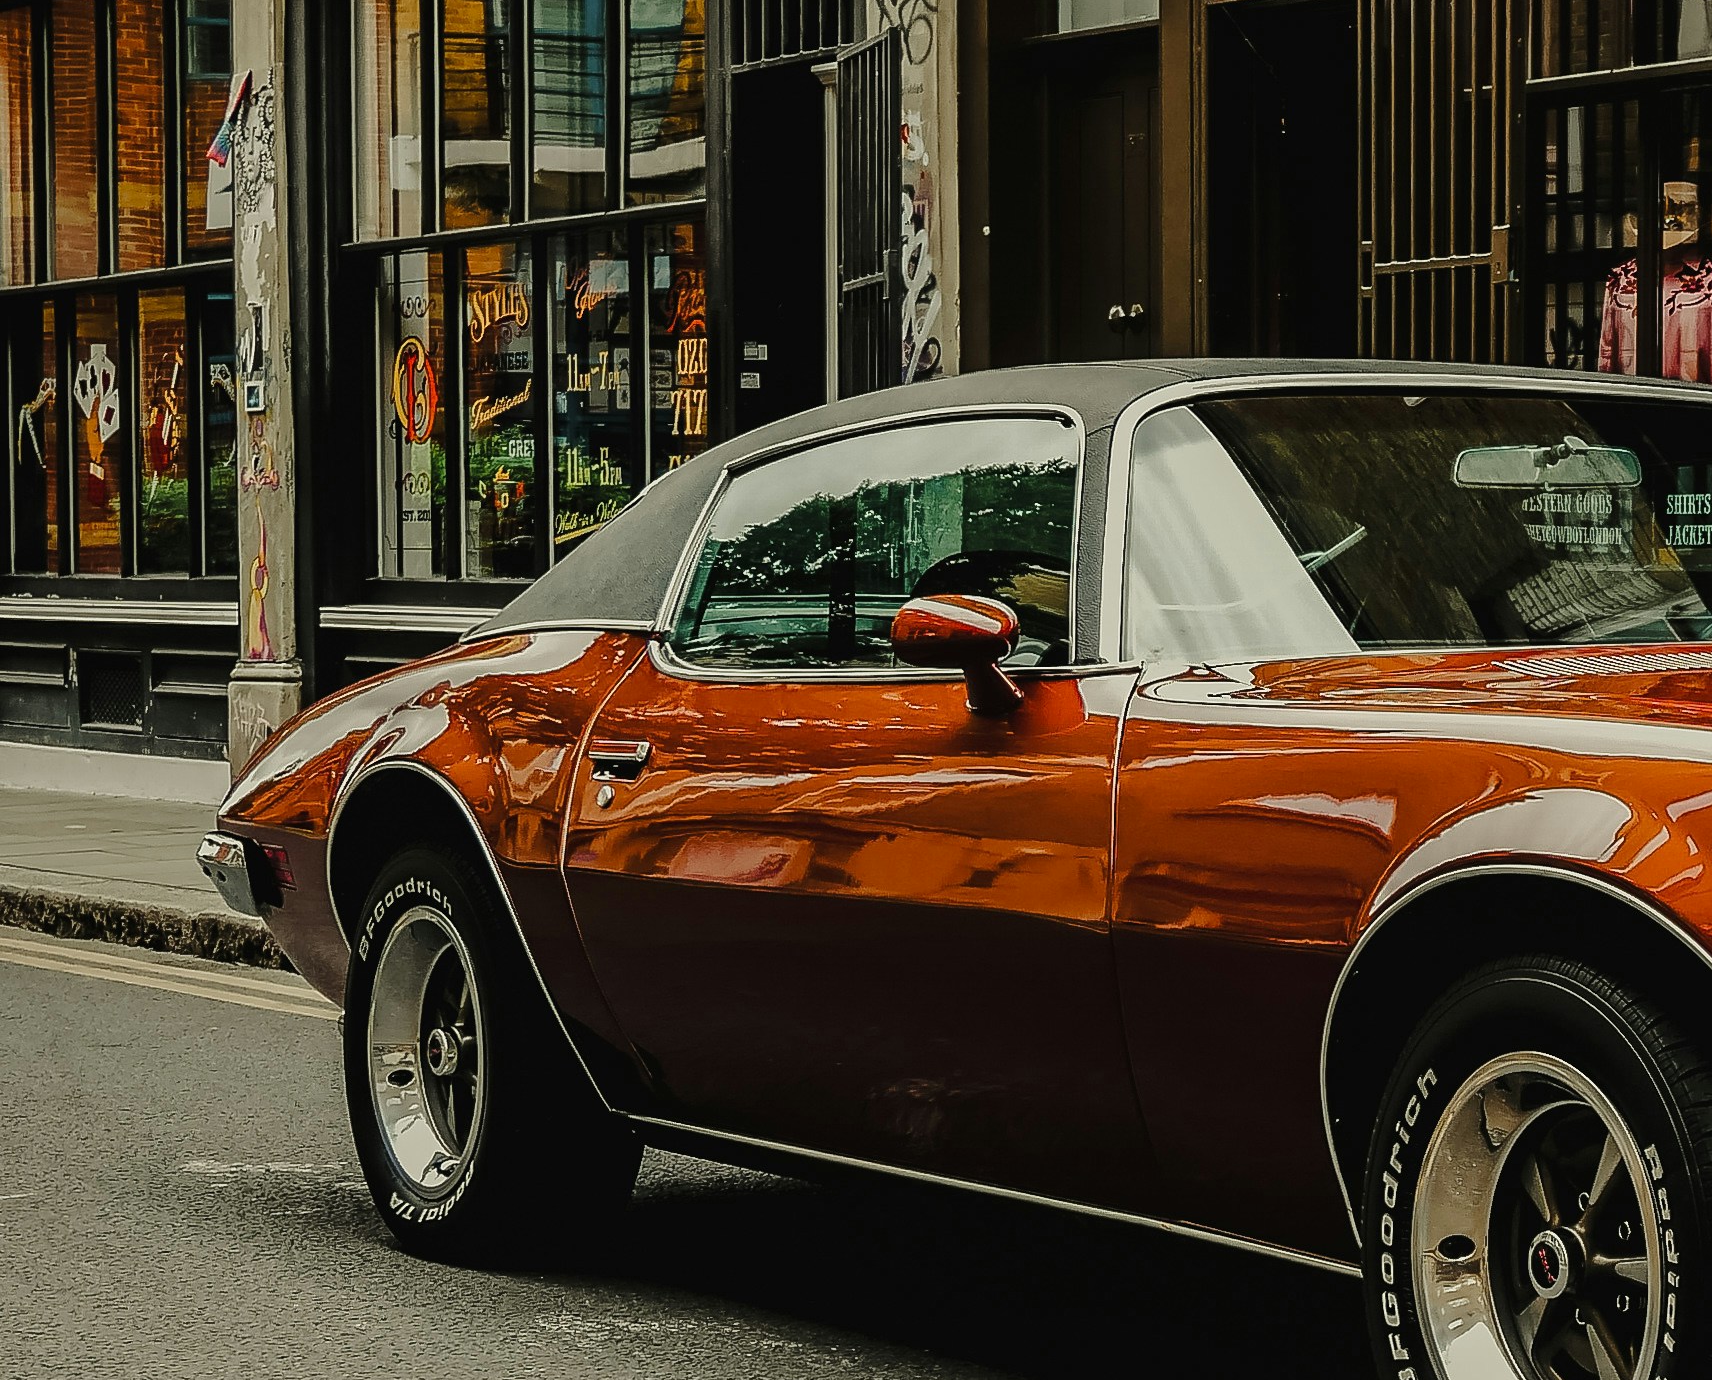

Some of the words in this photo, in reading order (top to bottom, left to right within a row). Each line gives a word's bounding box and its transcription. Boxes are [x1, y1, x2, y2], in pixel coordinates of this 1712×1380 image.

[470, 280, 529, 343] STYLES
[470, 378, 532, 430] Traditional
[1576, 493, 1613, 514] GOODS
[1666, 493, 1712, 515] SHIRTS
[358, 876, 453, 962] BFGoodrich
[416, 1159, 475, 1223] Radial
[1643, 1142, 1682, 1354] Radial
